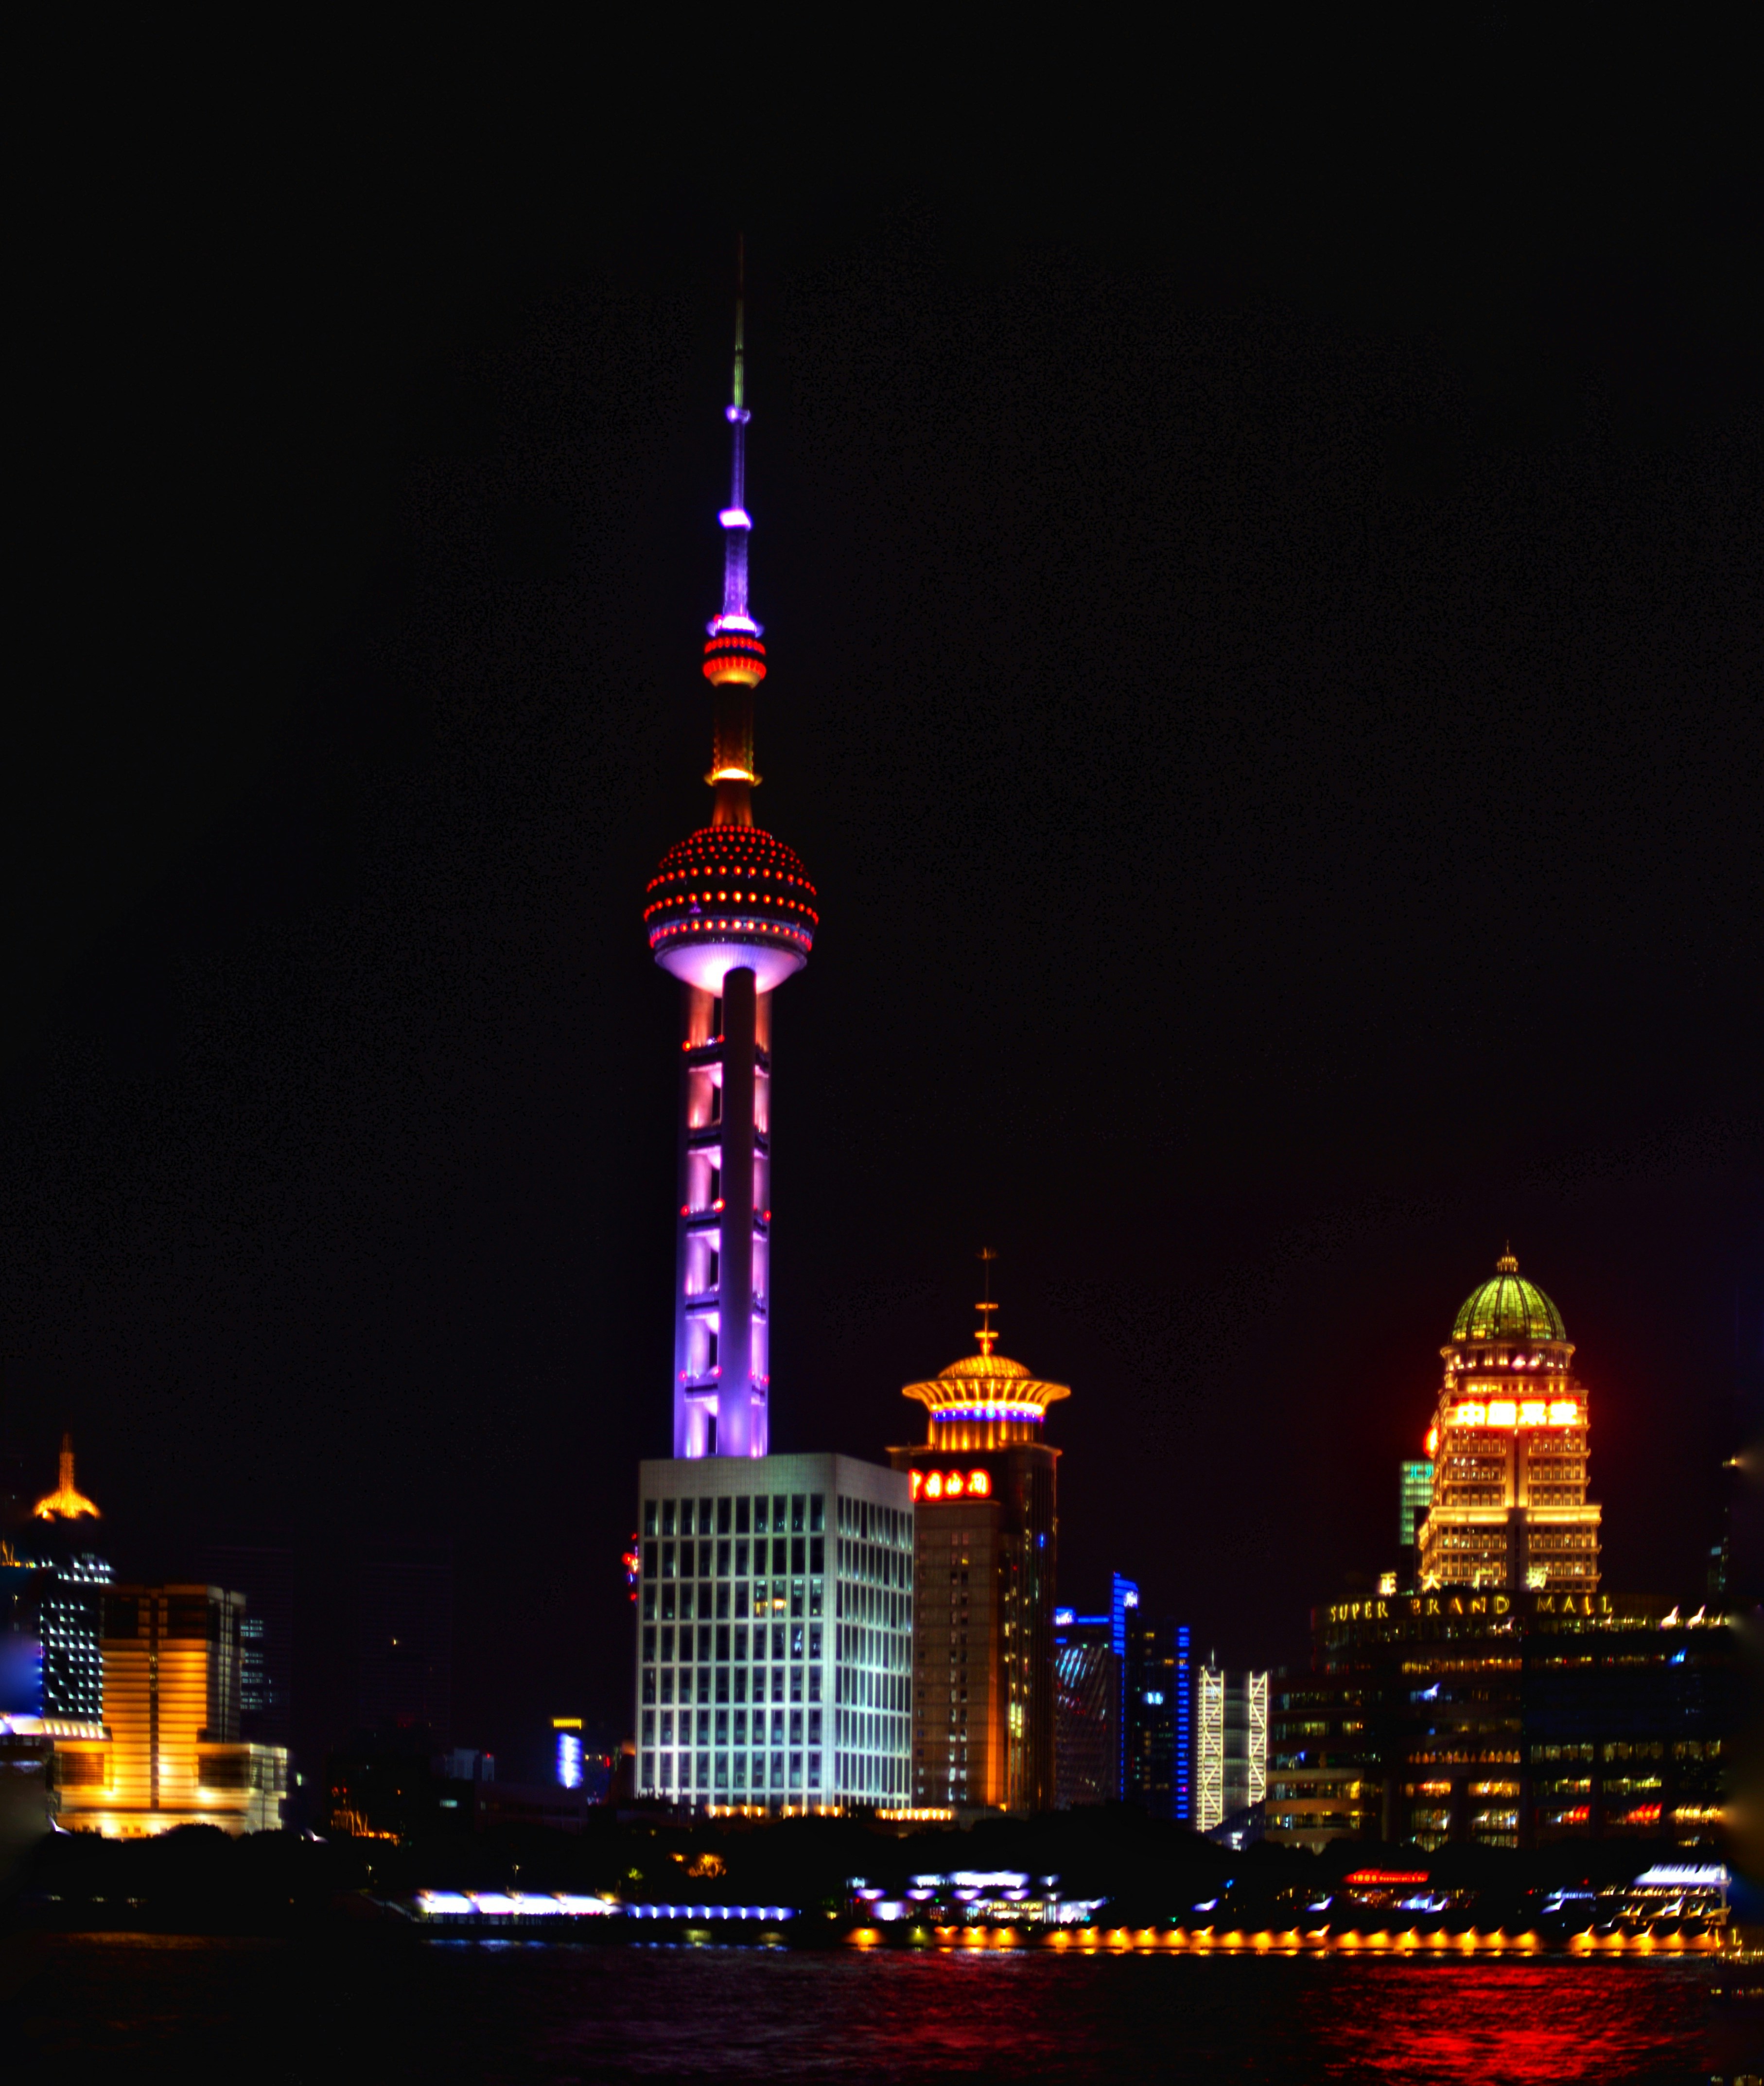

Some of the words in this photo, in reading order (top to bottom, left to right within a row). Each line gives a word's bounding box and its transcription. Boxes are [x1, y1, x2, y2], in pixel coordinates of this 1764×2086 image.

[1379, 1567, 1548, 1594] 正大广场
[1330, 1600, 1388, 1622] SUPER
[1411, 1595, 1509, 1616] BRAND
[1537, 1595, 1612, 1615] MALL
